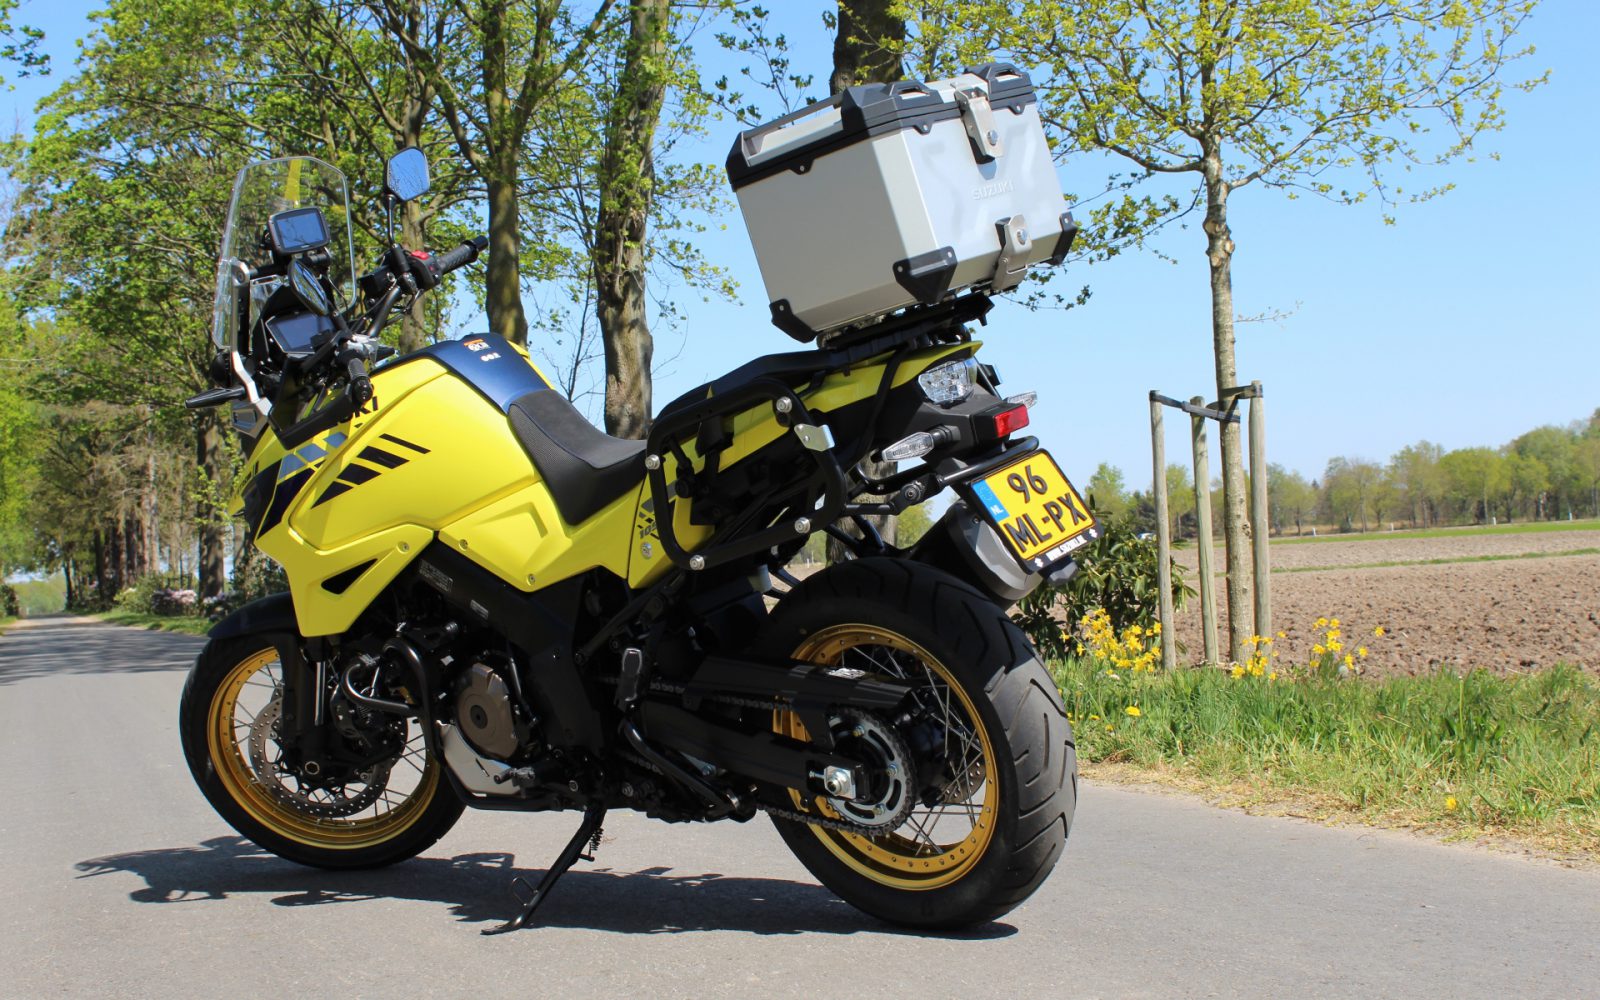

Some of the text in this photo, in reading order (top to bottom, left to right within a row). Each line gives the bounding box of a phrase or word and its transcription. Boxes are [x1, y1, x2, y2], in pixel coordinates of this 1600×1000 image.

[972, 181, 1014, 200] SUZUKI
[1007, 464, 1048, 504] 96
[991, 504, 1003, 515] NL
[1003, 493, 1087, 553] ML-PX
